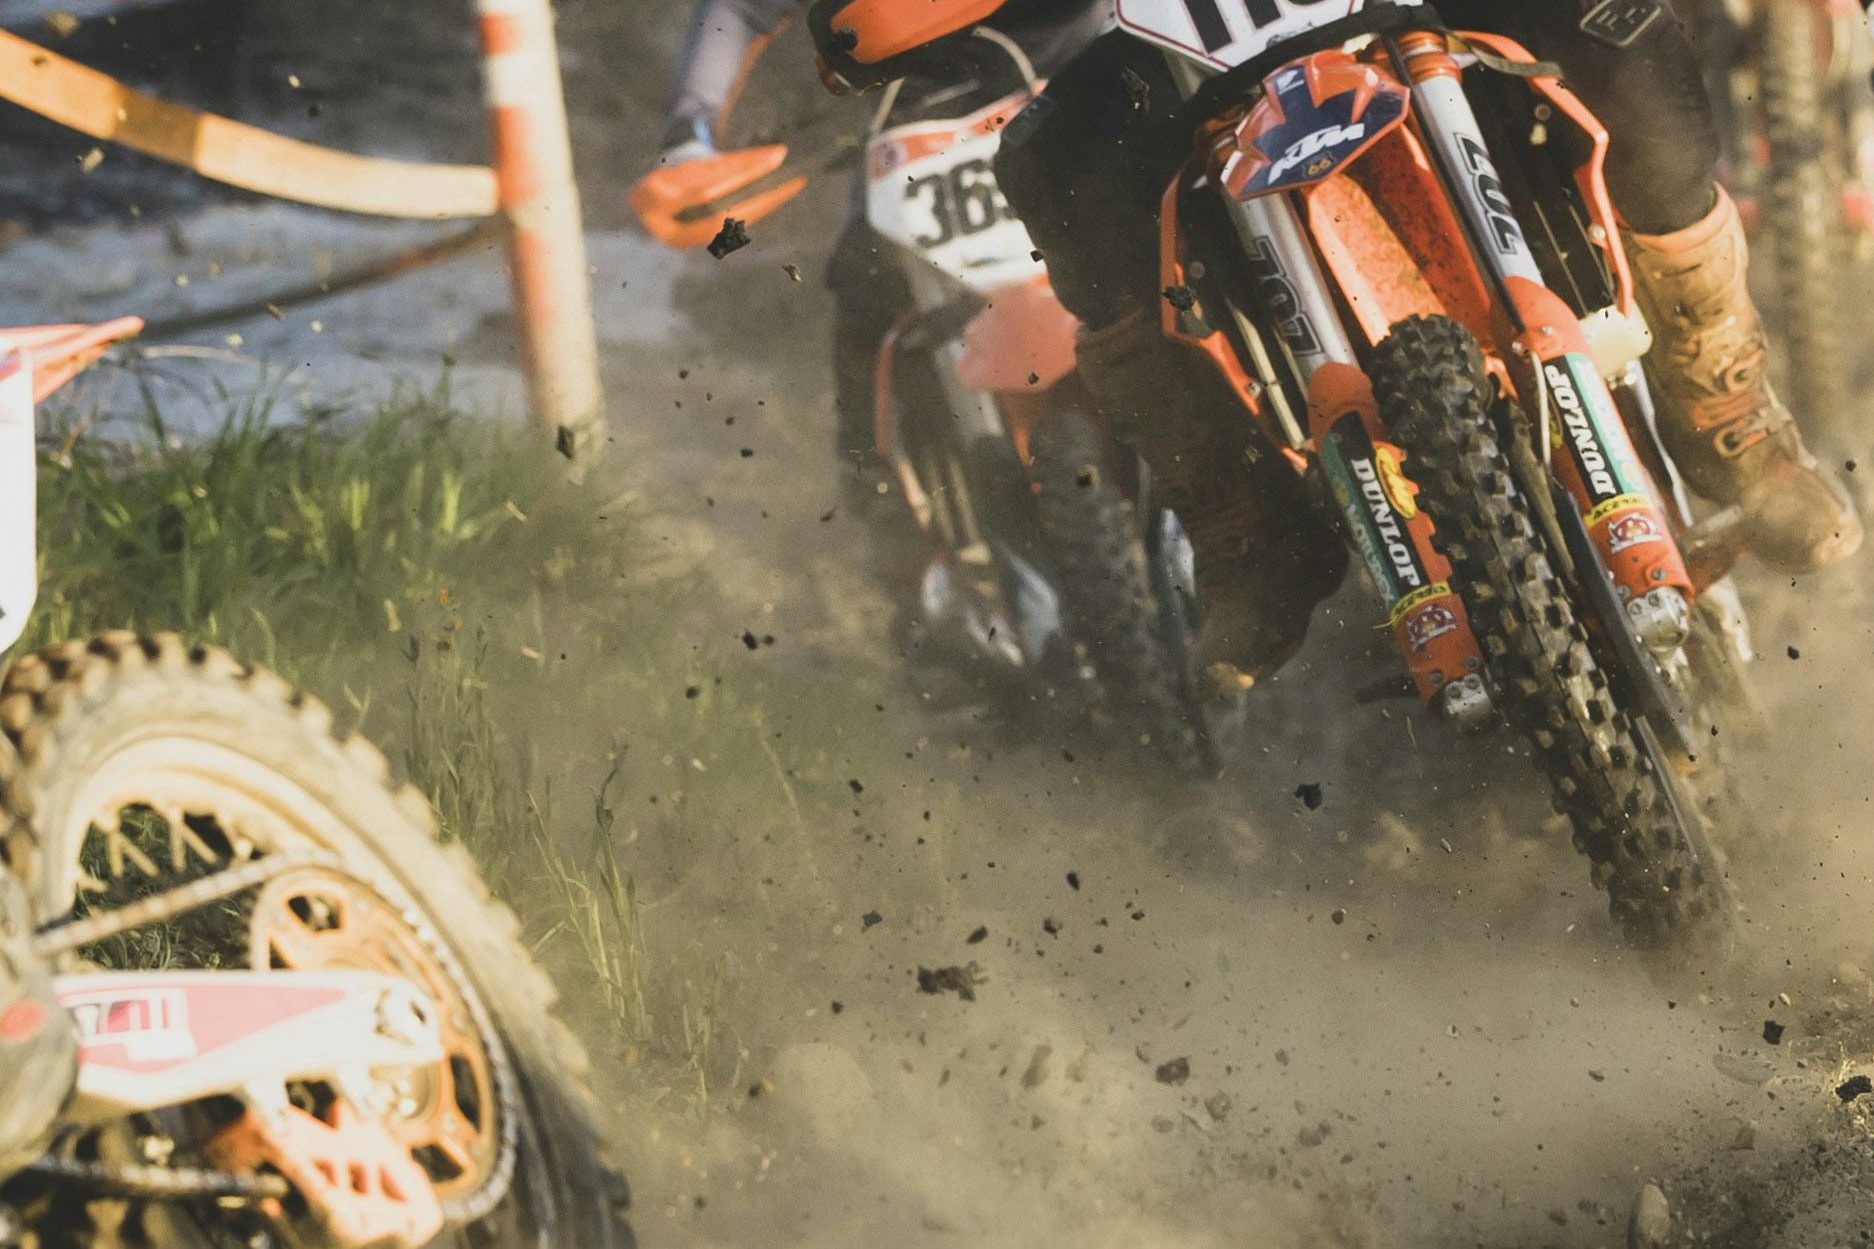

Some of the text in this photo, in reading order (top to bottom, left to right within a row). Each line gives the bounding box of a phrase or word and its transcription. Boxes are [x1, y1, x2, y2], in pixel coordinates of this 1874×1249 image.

[905, 160, 1018, 248] 36
[1268, 123, 1365, 185] KTM
[1544, 364, 1617, 495] DUNLOP
[1350, 458, 1421, 586] DUNLOP
